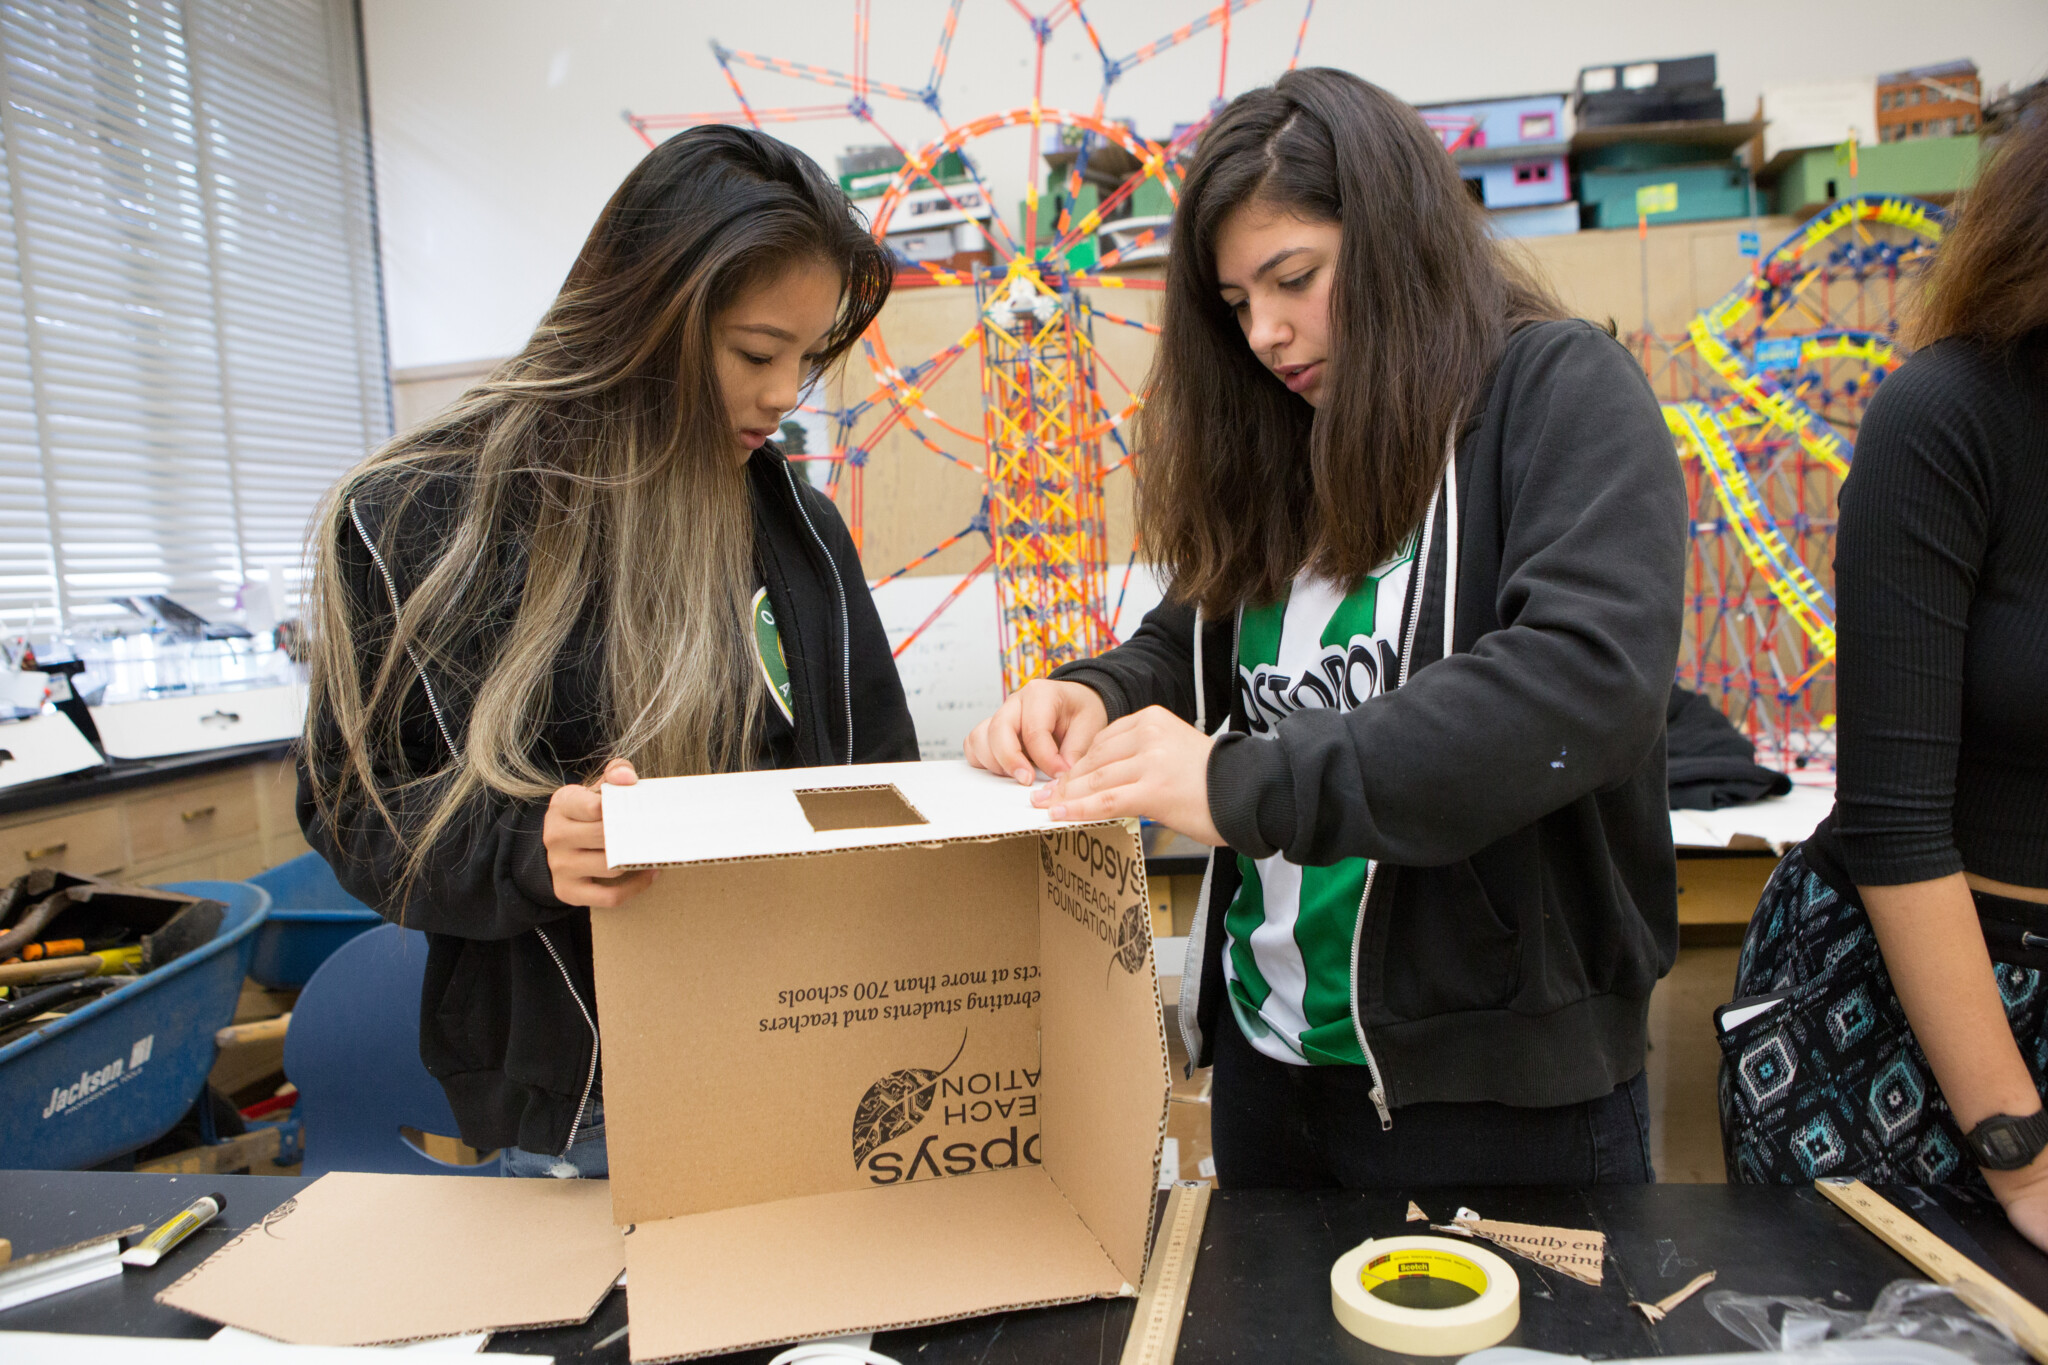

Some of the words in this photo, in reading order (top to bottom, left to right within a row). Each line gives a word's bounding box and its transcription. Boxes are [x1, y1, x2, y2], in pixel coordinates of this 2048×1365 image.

[1044, 830, 1140, 896] ynopsys
[1056, 864, 1116, 920] OUTREACH
[1048, 881, 1117, 949] FOUNDATION
[941, 971, 987, 987] more
[991, 968, 1009, 983] at
[1013, 965, 1041, 981] cts
[853, 981, 890, 1001] 700
[894, 975, 936, 993] than
[778, 984, 848, 1007] schools
[967, 990, 1041, 1013] ebrating
[843, 1009, 879, 1027] and
[883, 998, 962, 1018] students
[759, 1012, 838, 1033] teachers
[43, 1058, 124, 1119] Jackson
[942, 1068, 1041, 1098] ATION
[944, 1095, 1037, 1126] EACH
[1400, 1263, 1428, 1272] Scotch
